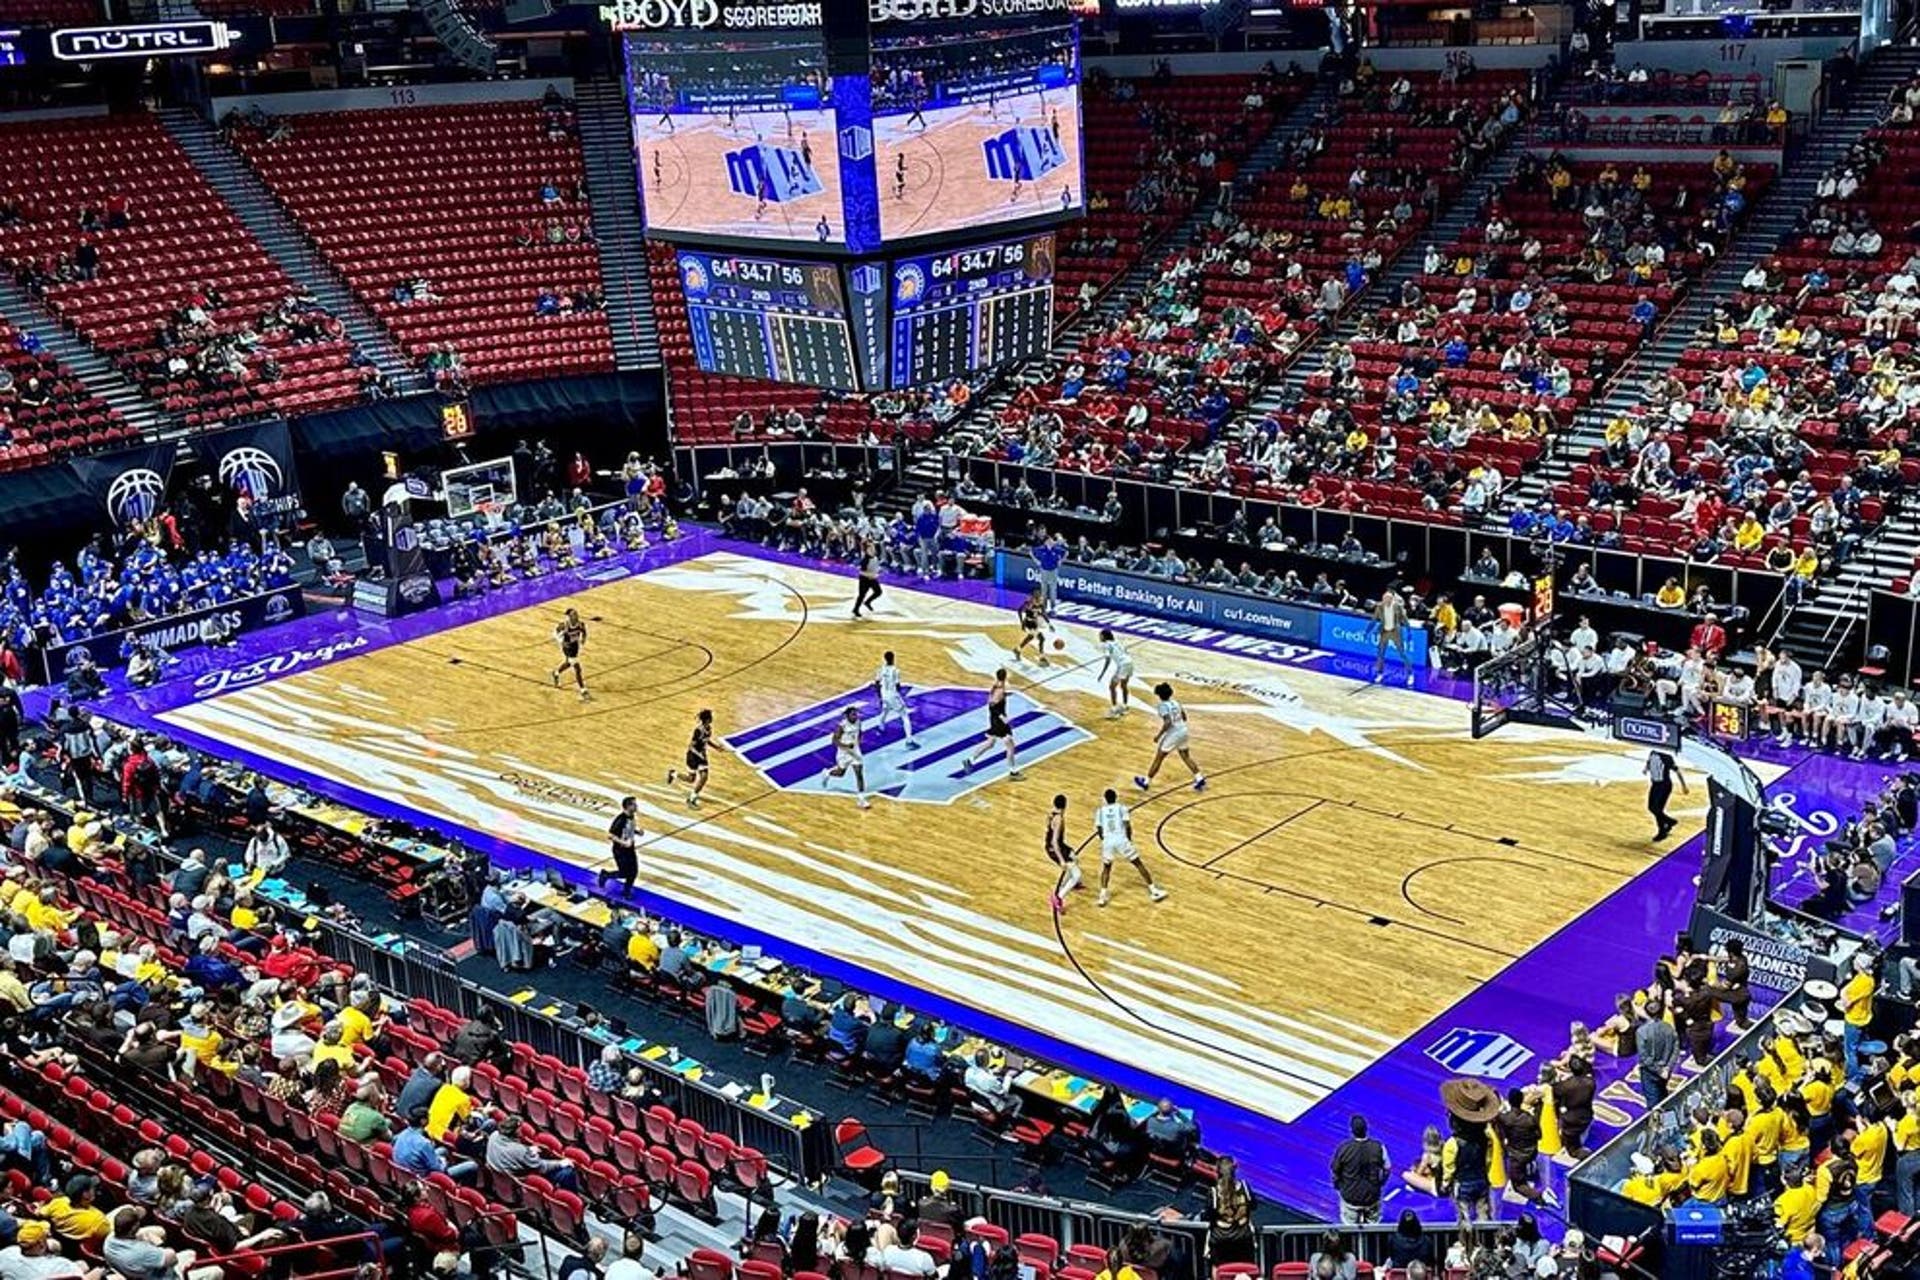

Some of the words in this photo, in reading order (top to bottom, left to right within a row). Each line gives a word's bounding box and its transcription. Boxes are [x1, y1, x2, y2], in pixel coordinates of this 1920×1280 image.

[617, 0, 719, 28] BOYD
[1719, 43, 1746, 62] 117
[390, 88, 416, 105] 113
[711, 259, 731, 278] 64
[739, 263, 773, 282] 34.7
[782, 267, 804, 285] 56
[931, 258, 952, 278] 64
[961, 250, 996, 272] 34.7
[1003, 244, 1024, 263] 56
[751, 289, 771, 302] 2ND
[968, 277, 988, 292] 2ND
[1077, 576, 1113, 597] Better
[1115, 584, 1164, 609] Banking
[1166, 595, 1184, 611] for
[1188, 599, 1204, 613] All
[1223, 605, 1293, 630] cu1.com/mw
[255, 637, 368, 674] Vegas
[1213, 631, 1336, 668] WEST
[1718, 717, 1739, 734] 28
